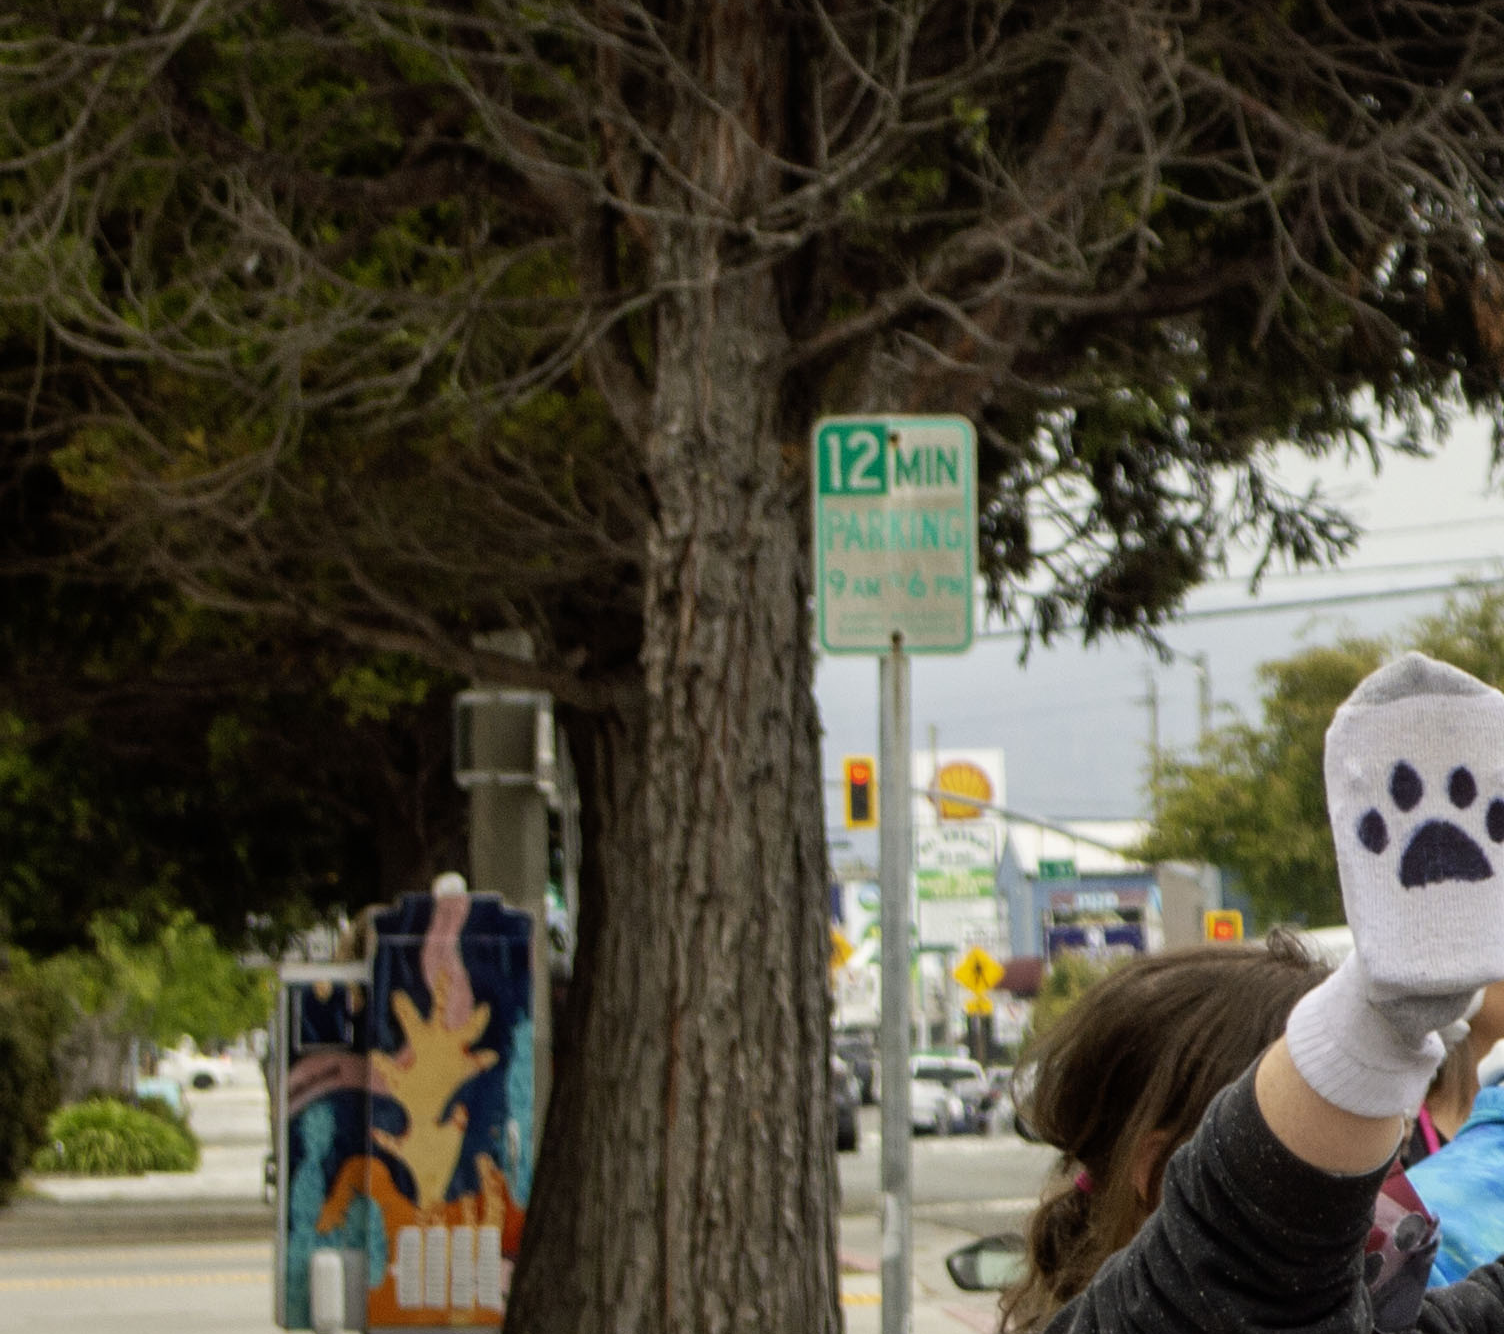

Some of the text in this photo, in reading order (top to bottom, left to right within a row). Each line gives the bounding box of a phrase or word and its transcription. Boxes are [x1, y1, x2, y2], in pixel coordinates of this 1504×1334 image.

[827, 430, 960, 491] 12 MIN
[825, 509, 965, 553] PARKING
[828, 568, 848, 598] 9
[908, 569, 927, 598] 6
